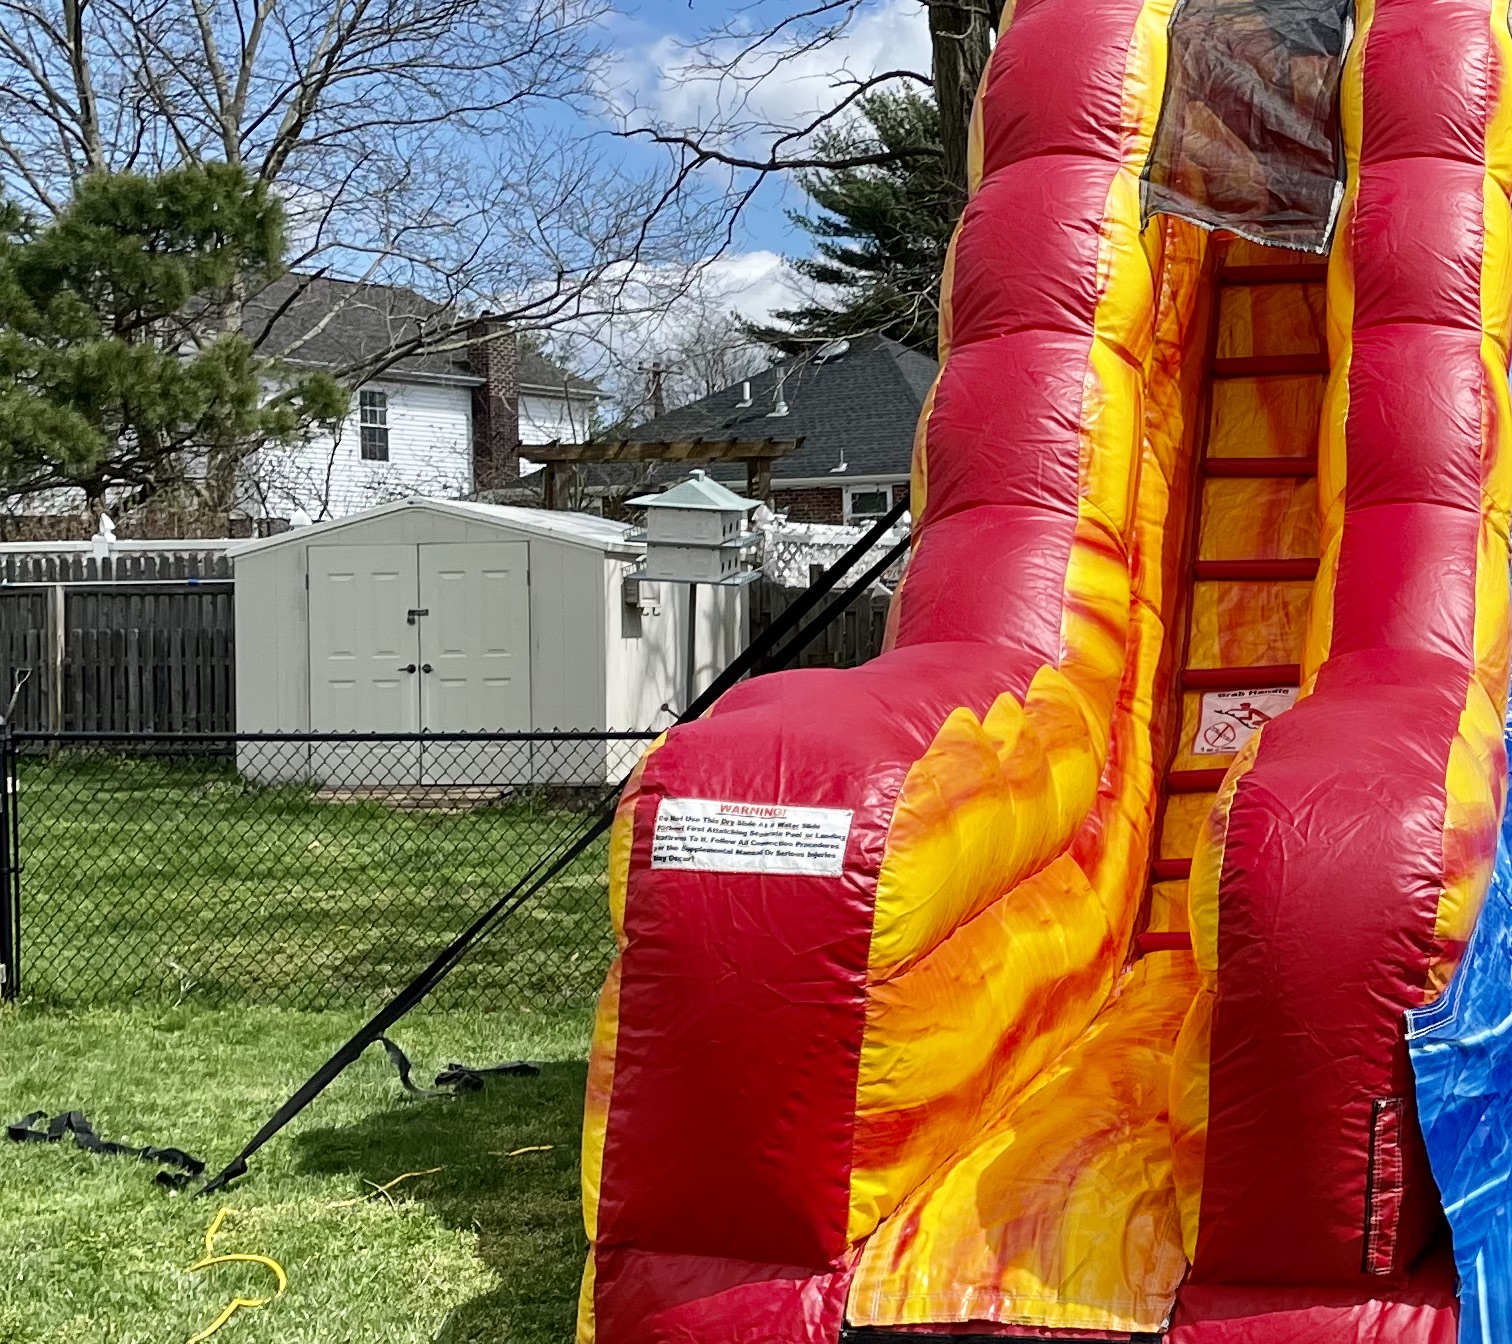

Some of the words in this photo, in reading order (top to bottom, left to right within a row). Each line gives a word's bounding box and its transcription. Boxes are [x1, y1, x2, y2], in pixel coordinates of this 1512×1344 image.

[1248, 688, 1290, 696] Handle
[720, 803, 787, 817] WARNING!
[685, 815, 701, 823] Use
[703, 817, 719, 825] This
[720, 818, 735, 827] Dry
[815, 833, 846, 841] Landing
